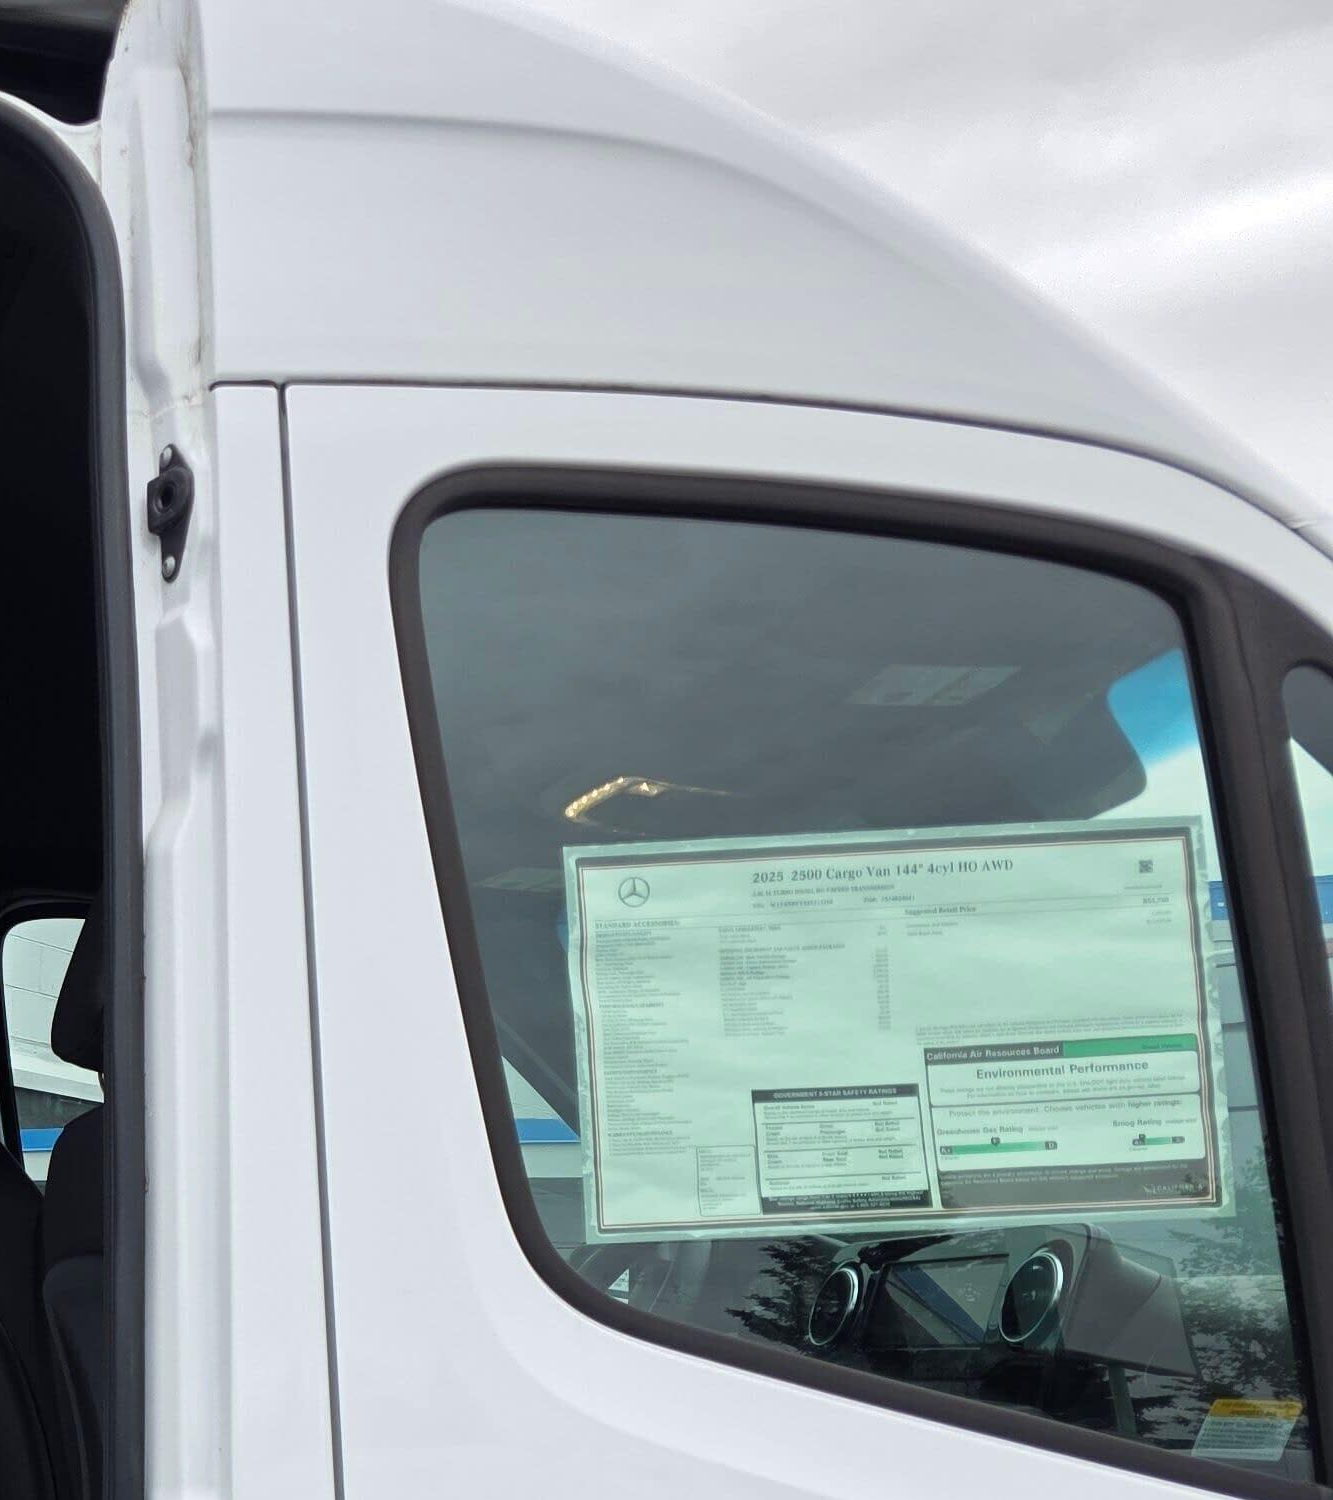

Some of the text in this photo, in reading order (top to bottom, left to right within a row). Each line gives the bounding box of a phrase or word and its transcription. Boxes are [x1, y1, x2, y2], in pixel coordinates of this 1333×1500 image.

[752, 859, 1014, 884] 2025 2500 Cargo Van 144" 4cyl HO AWD
[959, 905, 976, 913] Price
[926, 1045, 1060, 1061] California Air Resources Board
[976, 1060, 1149, 1080] Environmental Performance
[1128, 1100, 1151, 1109] higher
[1112, 1120, 1135, 1128] Smog
[1137, 1118, 1162, 1127] Rating
[983, 1126, 997, 1134] Gas
[999, 1125, 1024, 1133] Rating
[1156, 1183, 1203, 1192] CALIFORNA
